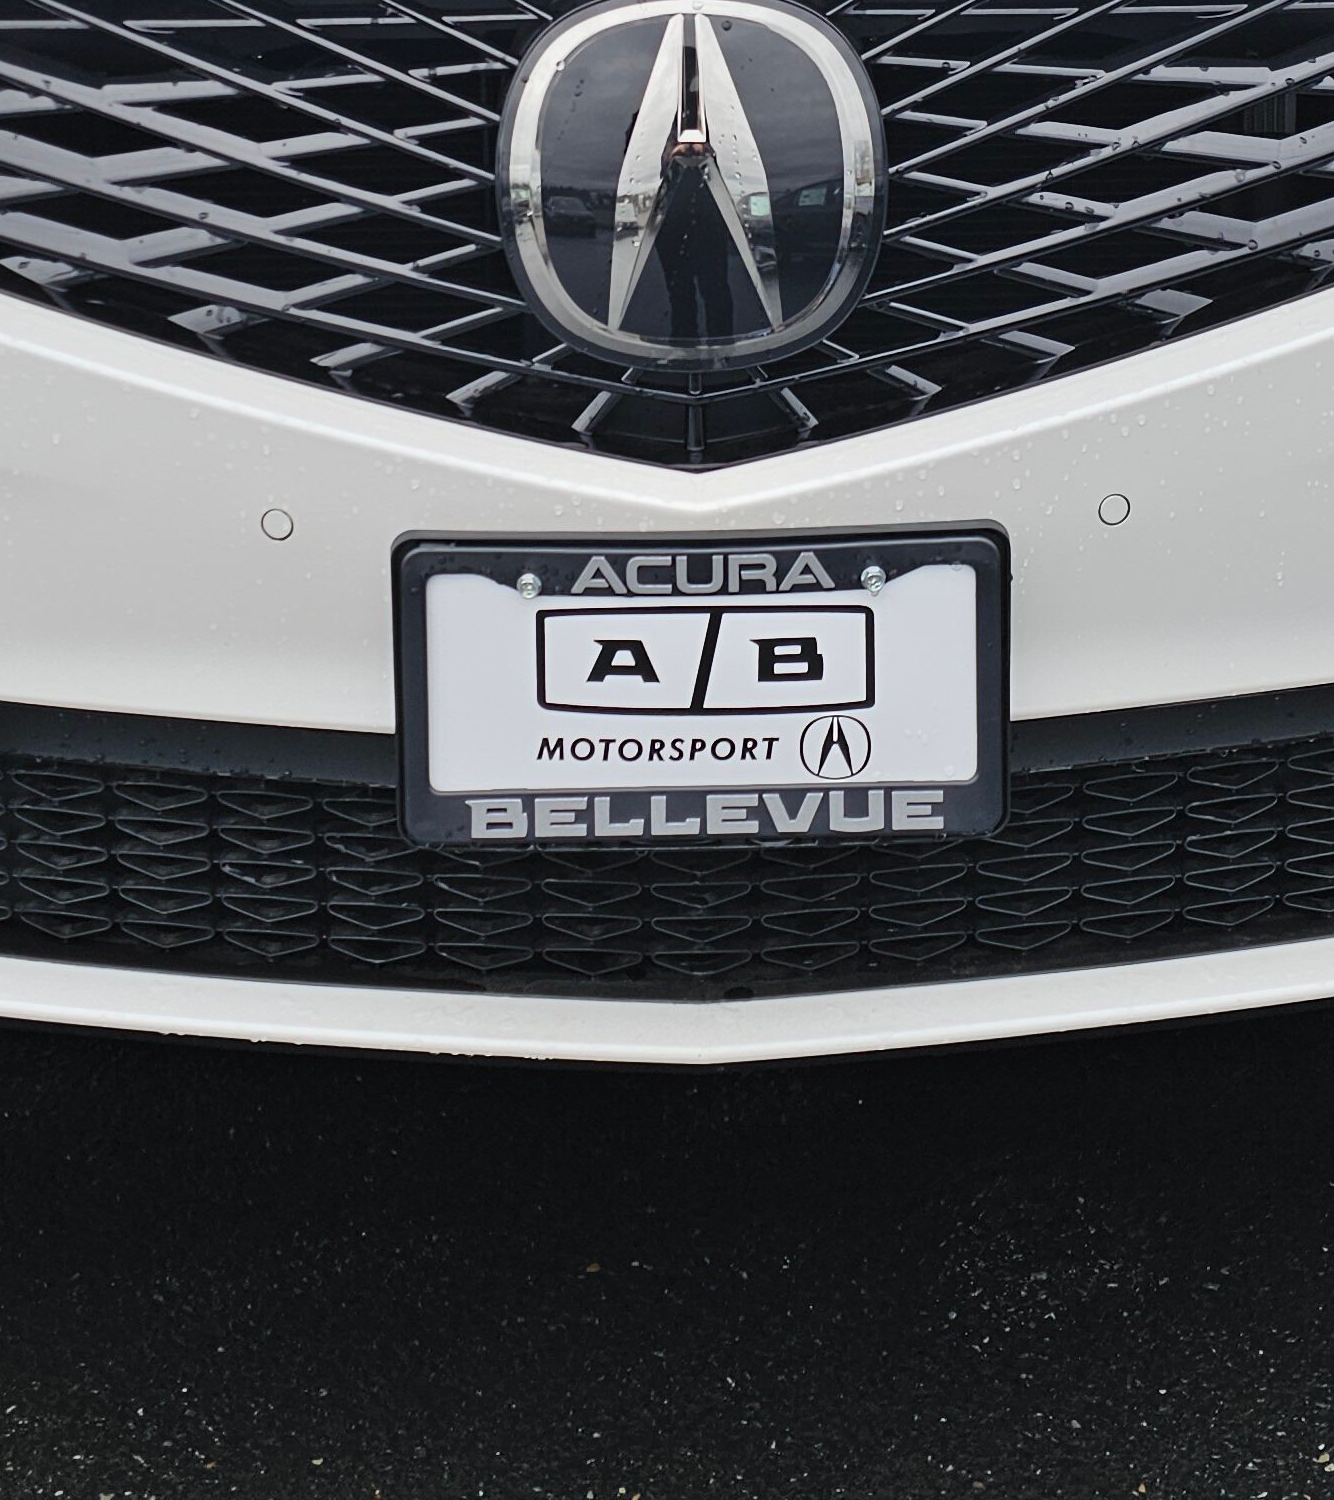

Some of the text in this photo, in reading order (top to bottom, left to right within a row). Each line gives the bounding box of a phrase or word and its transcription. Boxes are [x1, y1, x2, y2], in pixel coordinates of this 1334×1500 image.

[571, 550, 835, 595] ACURA
[537, 736, 780, 762] MOTORSPORT
[467, 789, 945, 839] BELLEVUE
